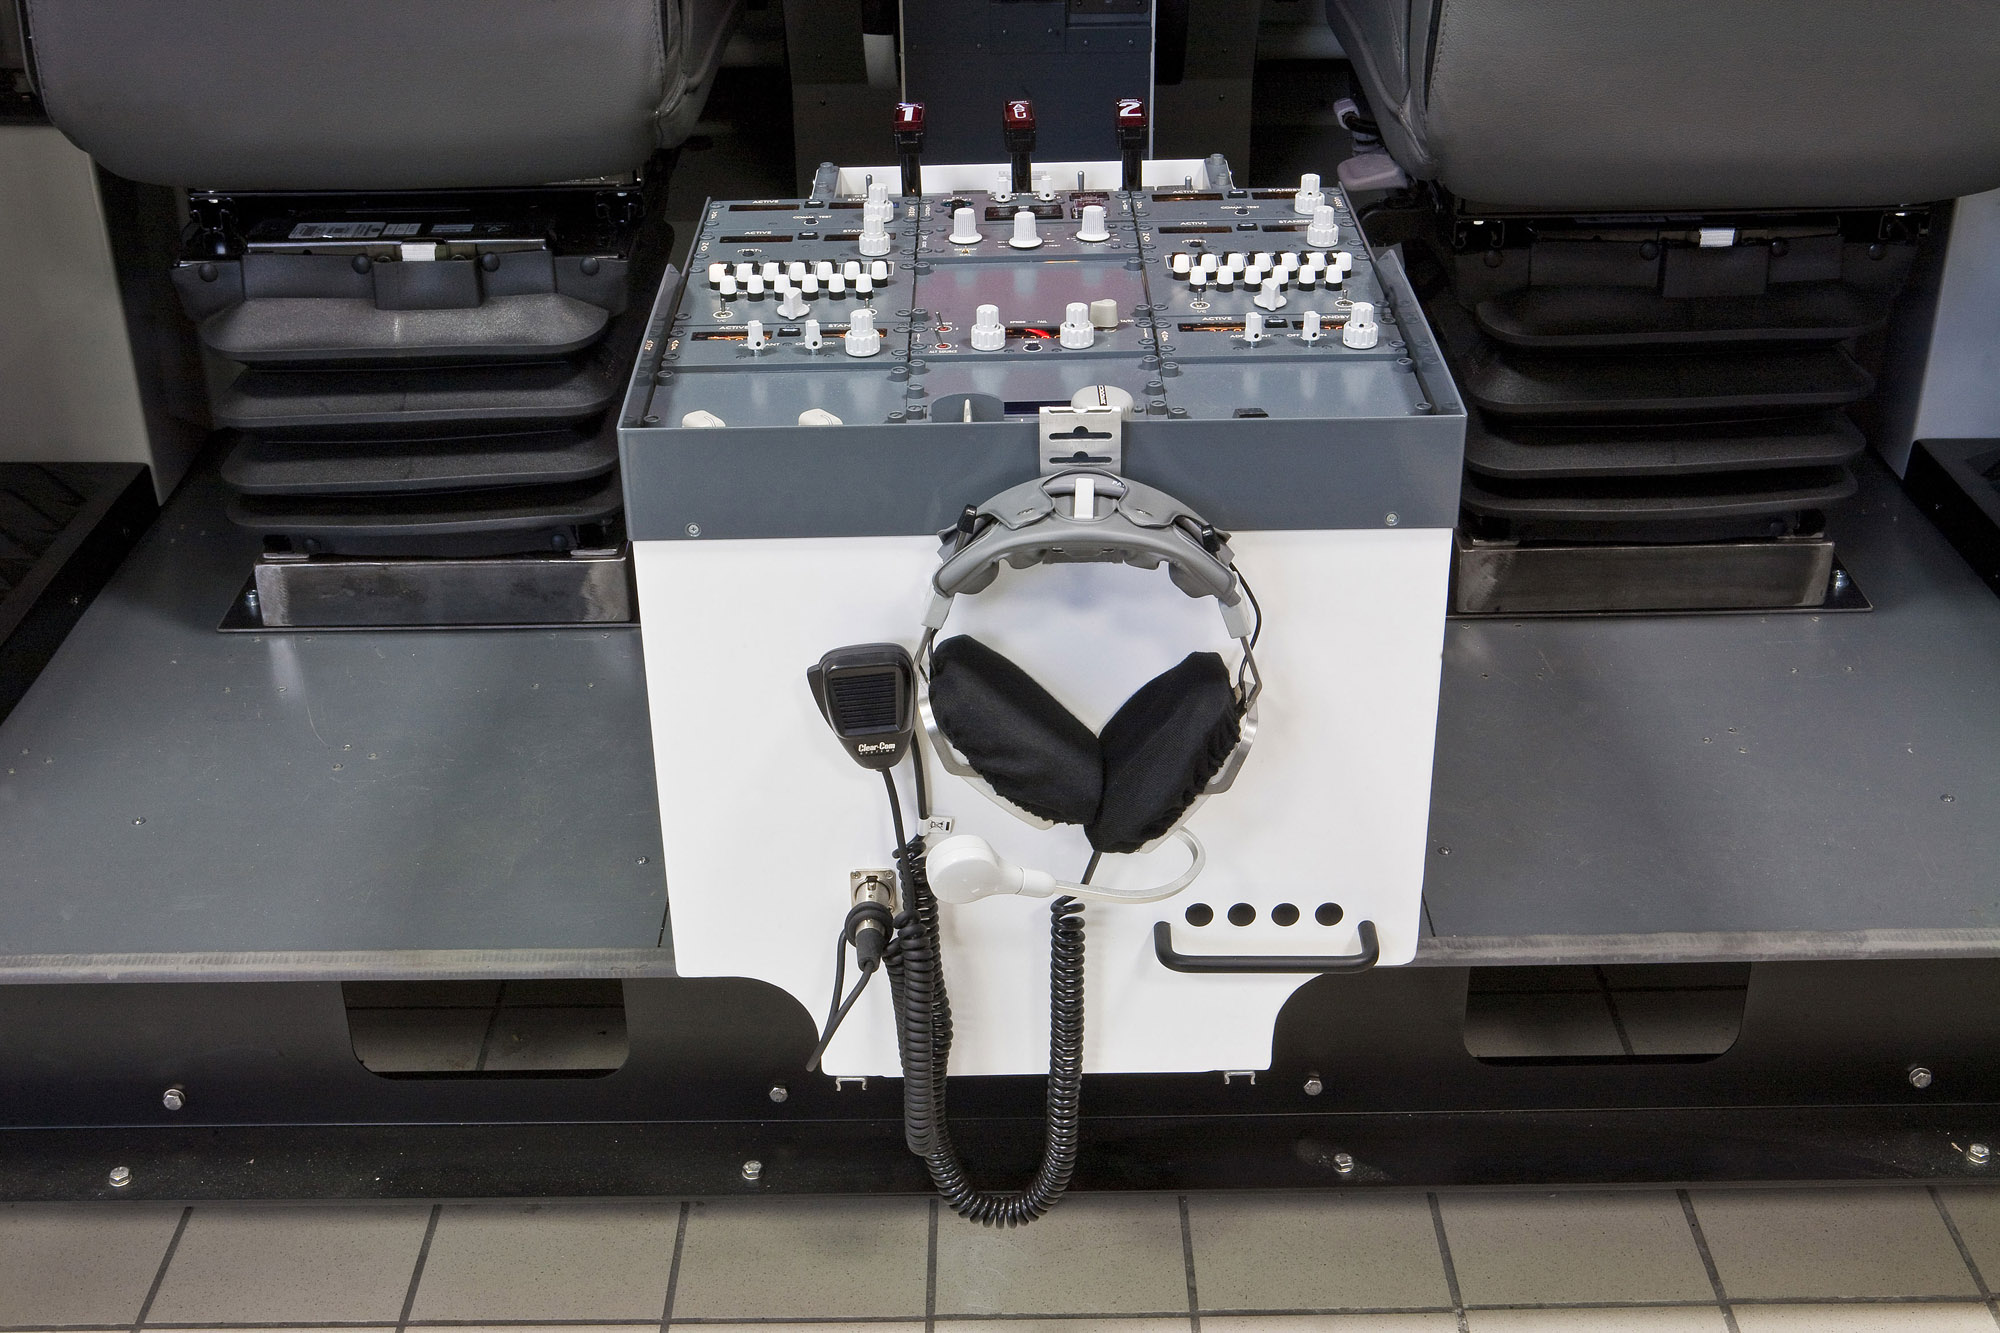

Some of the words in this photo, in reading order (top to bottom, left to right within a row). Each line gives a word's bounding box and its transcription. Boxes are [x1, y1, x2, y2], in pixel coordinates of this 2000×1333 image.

[901, 106, 914, 121] 1
[1119, 102, 1142, 117] 2
[858, 742, 896, 752] Clear-Com
